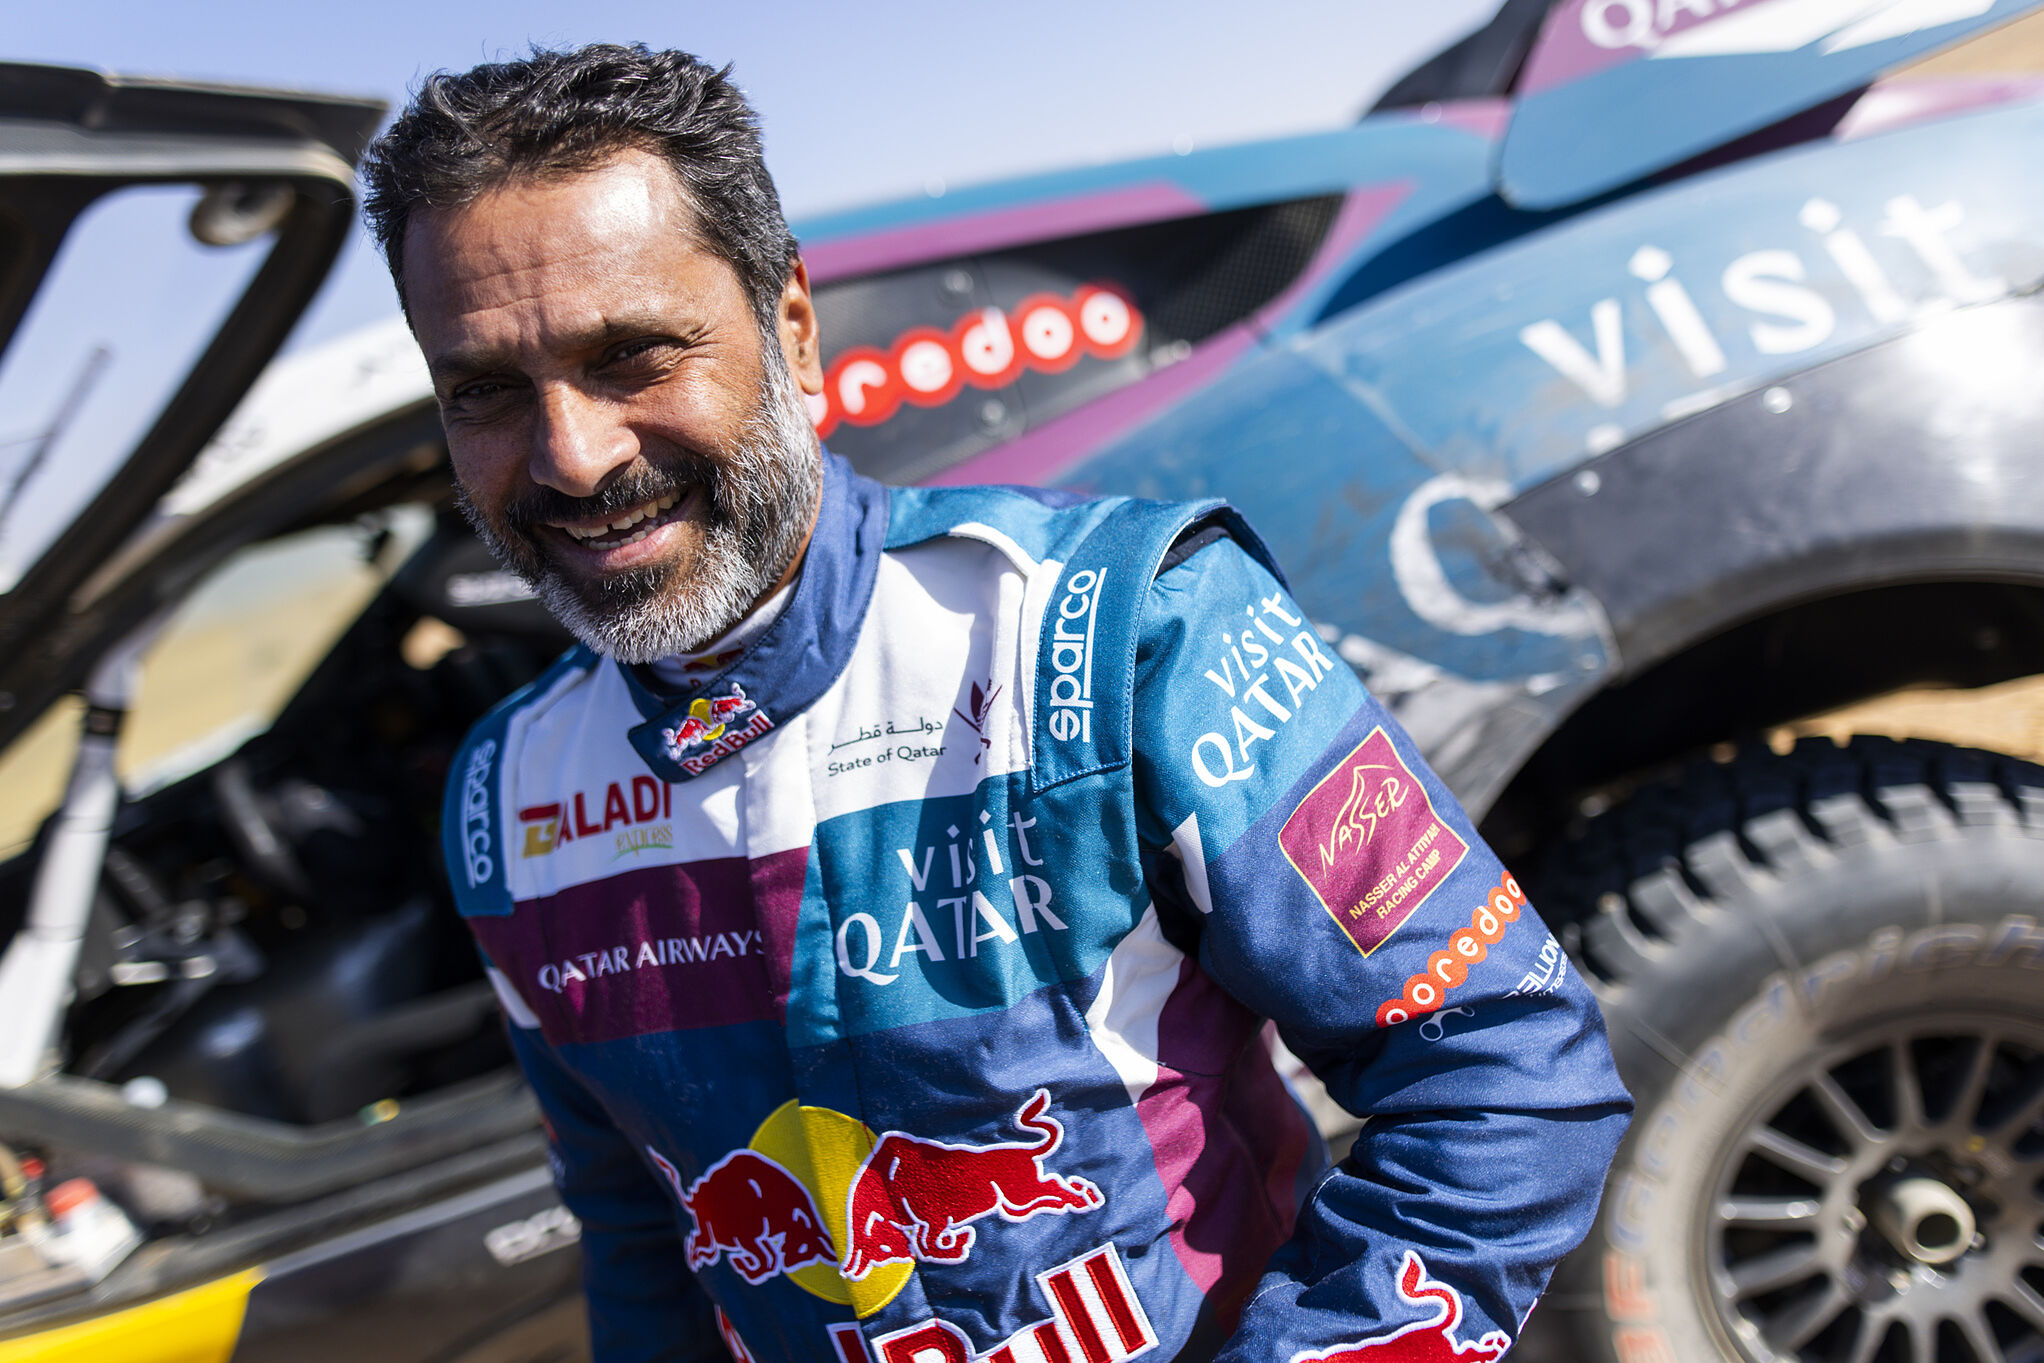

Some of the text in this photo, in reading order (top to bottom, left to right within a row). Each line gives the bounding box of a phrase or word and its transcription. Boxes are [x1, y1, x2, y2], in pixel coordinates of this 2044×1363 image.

[1520, 195, 2008, 404] visit
[1049, 569, 1099, 742] sparco
[1204, 591, 1302, 698] visit
[680, 708, 775, 776] Red Bull
[828, 745, 947, 777] State of Qatar
[1191, 630, 1334, 788] QATAR
[467, 739, 496, 884] sparco
[1318, 766, 1410, 882] NASSER
[1348, 823, 1442, 921] NASSER AL ATTIYAH
[1376, 849, 1442, 920] RACING CAMP
[537, 946, 631, 994] QATAR
[836, 874, 1069, 986] QATAR
[1385, 877, 1522, 1025] ooredoo
